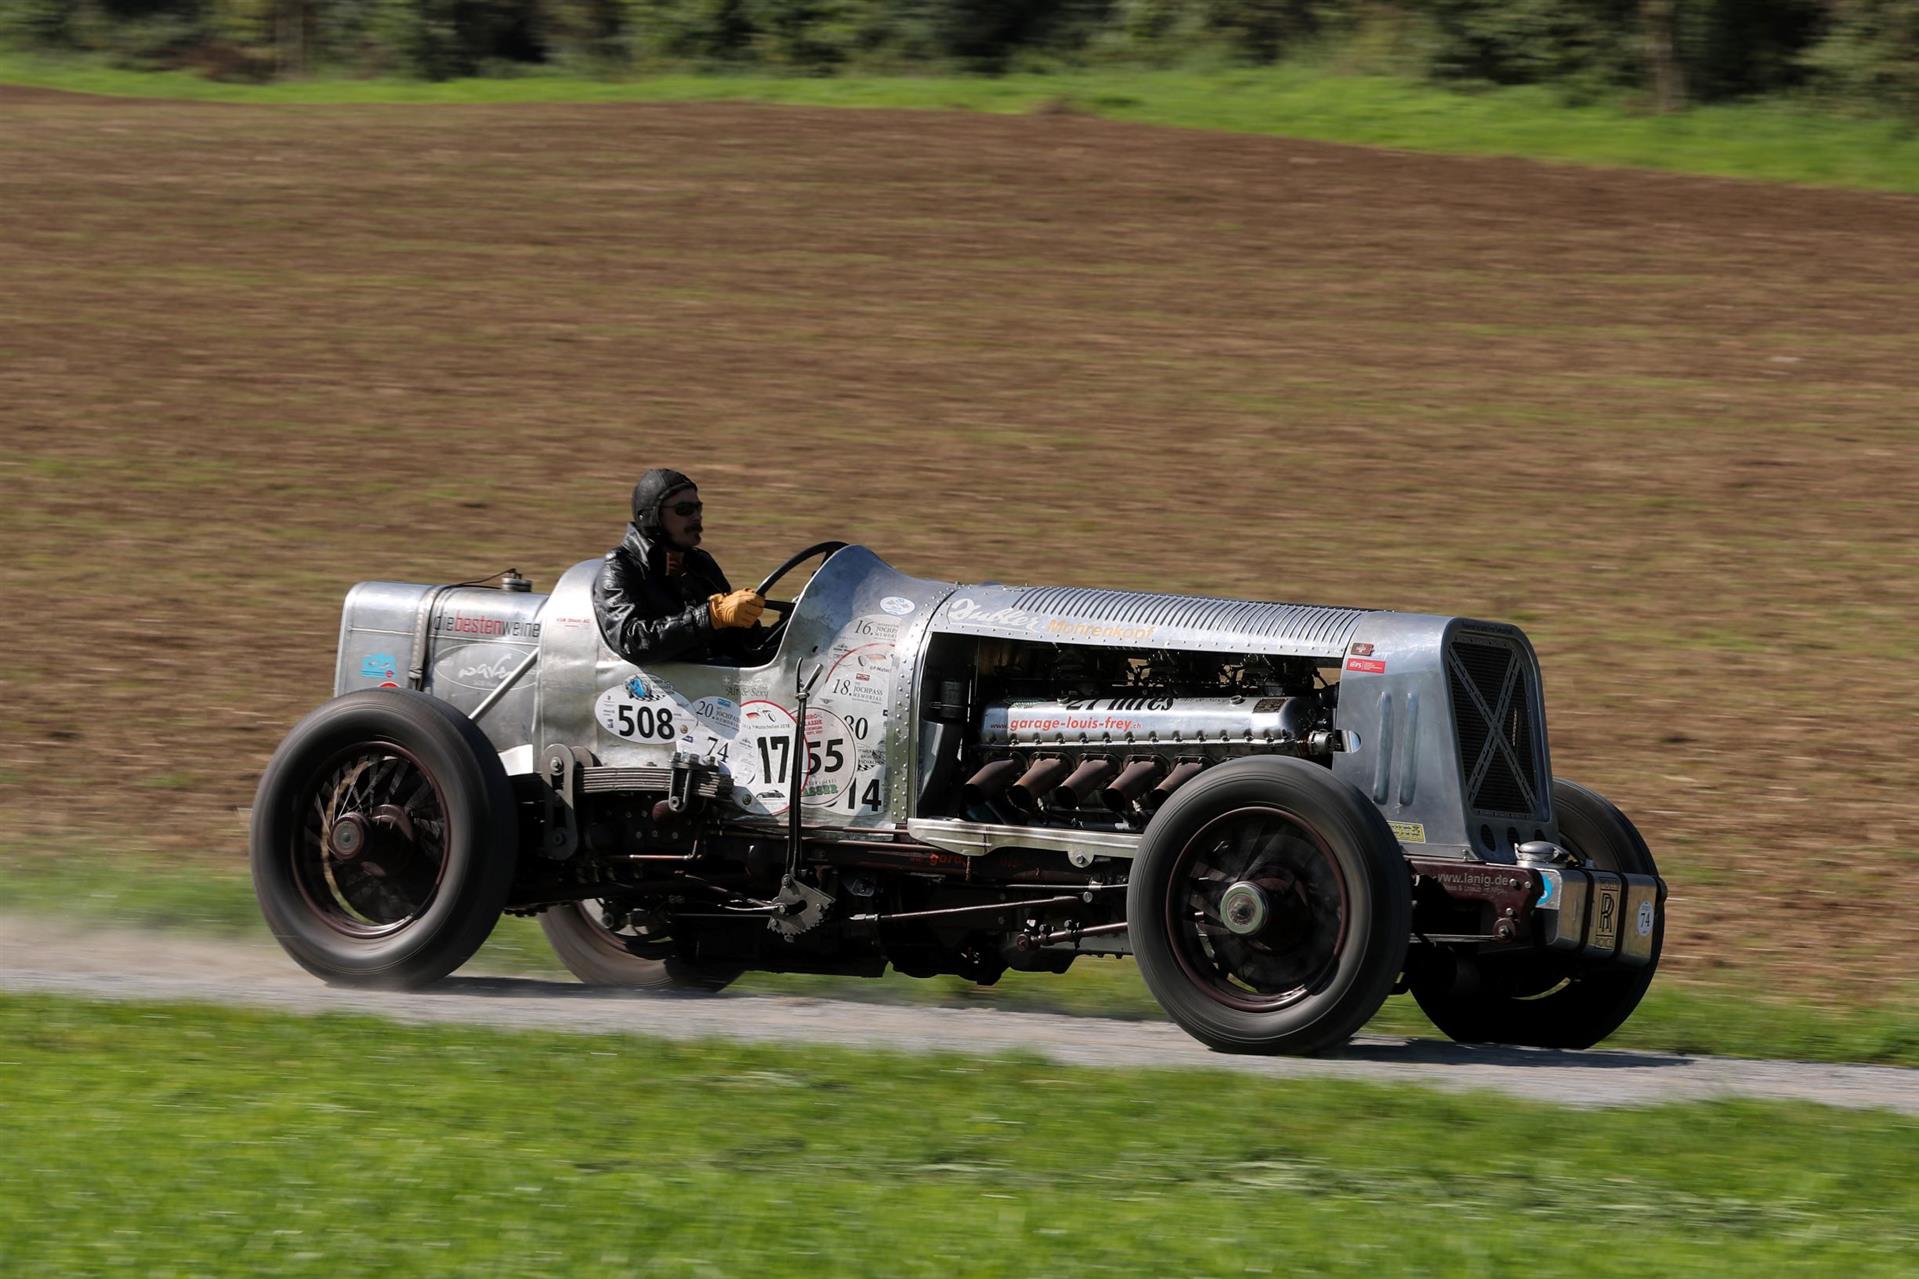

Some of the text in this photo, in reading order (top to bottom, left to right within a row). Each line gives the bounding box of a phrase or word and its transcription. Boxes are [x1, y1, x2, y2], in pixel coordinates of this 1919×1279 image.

[854, 620, 874, 636] 16.
[832, 679, 852, 696] 18.
[618, 704, 676, 740] 508
[695, 700, 716, 721] 20.
[706, 736, 729, 763] 74
[757, 736, 790, 784] 17
[808, 738, 845, 776] 55
[1640, 912, 1651, 929] 74
